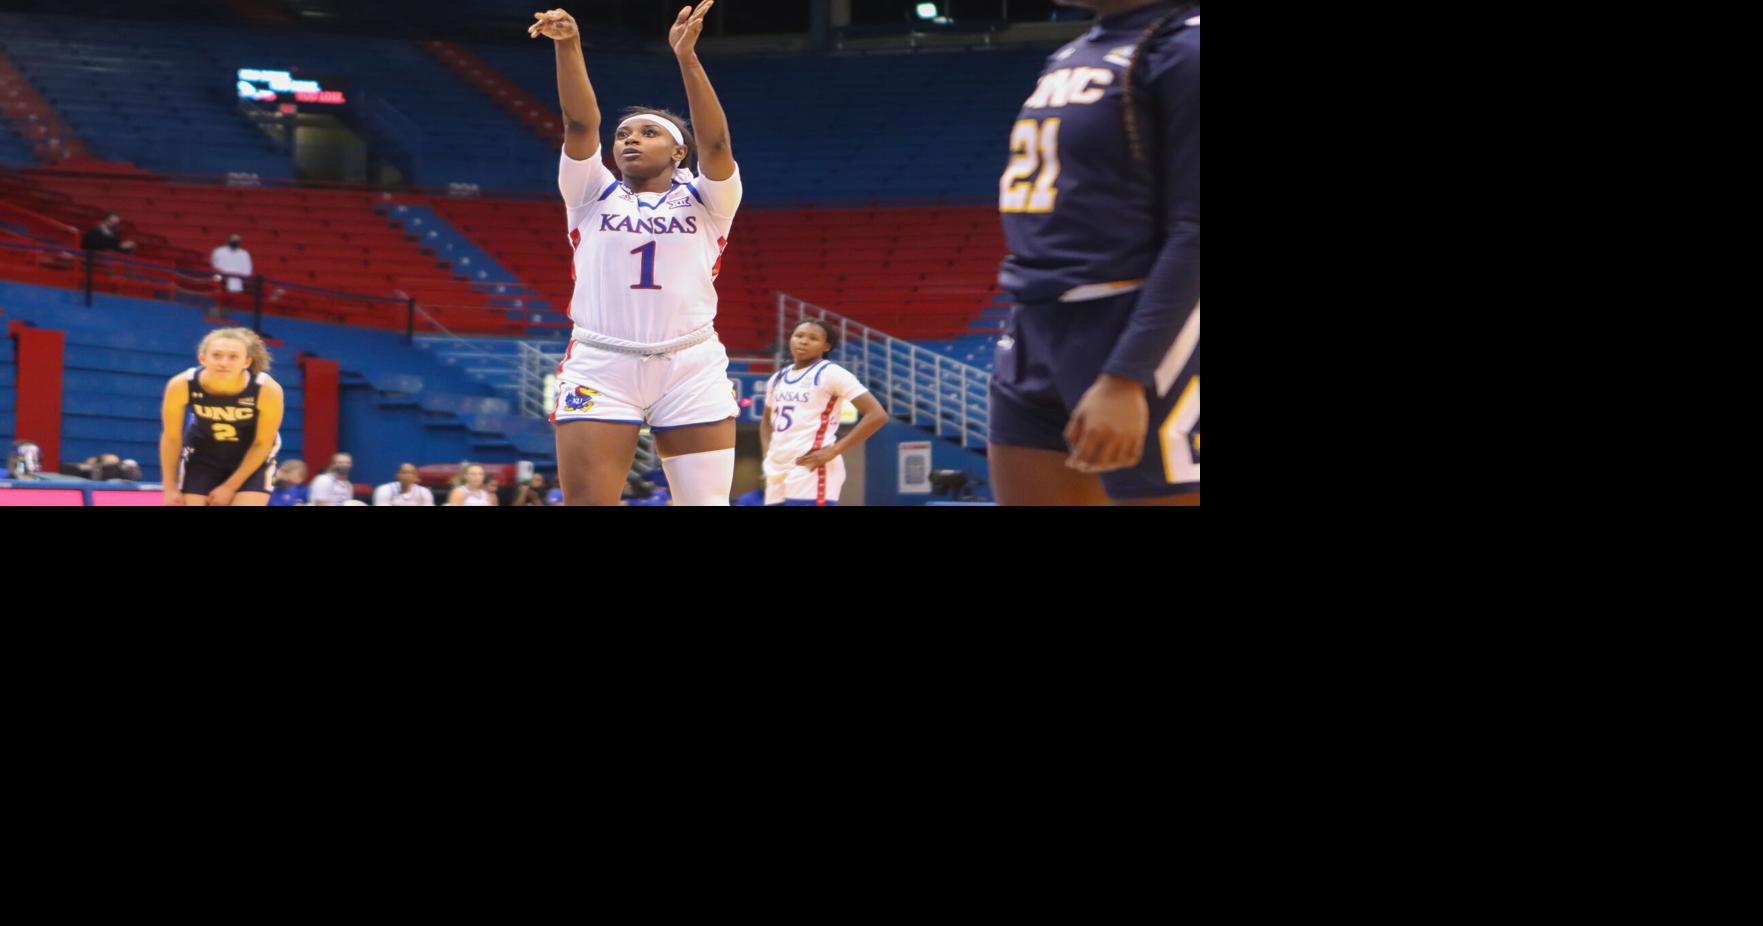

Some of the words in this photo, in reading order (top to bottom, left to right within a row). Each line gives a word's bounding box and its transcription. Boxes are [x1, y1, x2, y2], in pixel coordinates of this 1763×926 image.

[1024, 66, 1114, 109] NC
[999, 117, 1061, 213] 21
[600, 213, 697, 234] KANSAS
[630, 240, 662, 289] 1
[193, 404, 254, 421] UNC
[211, 422, 239, 442] 2
